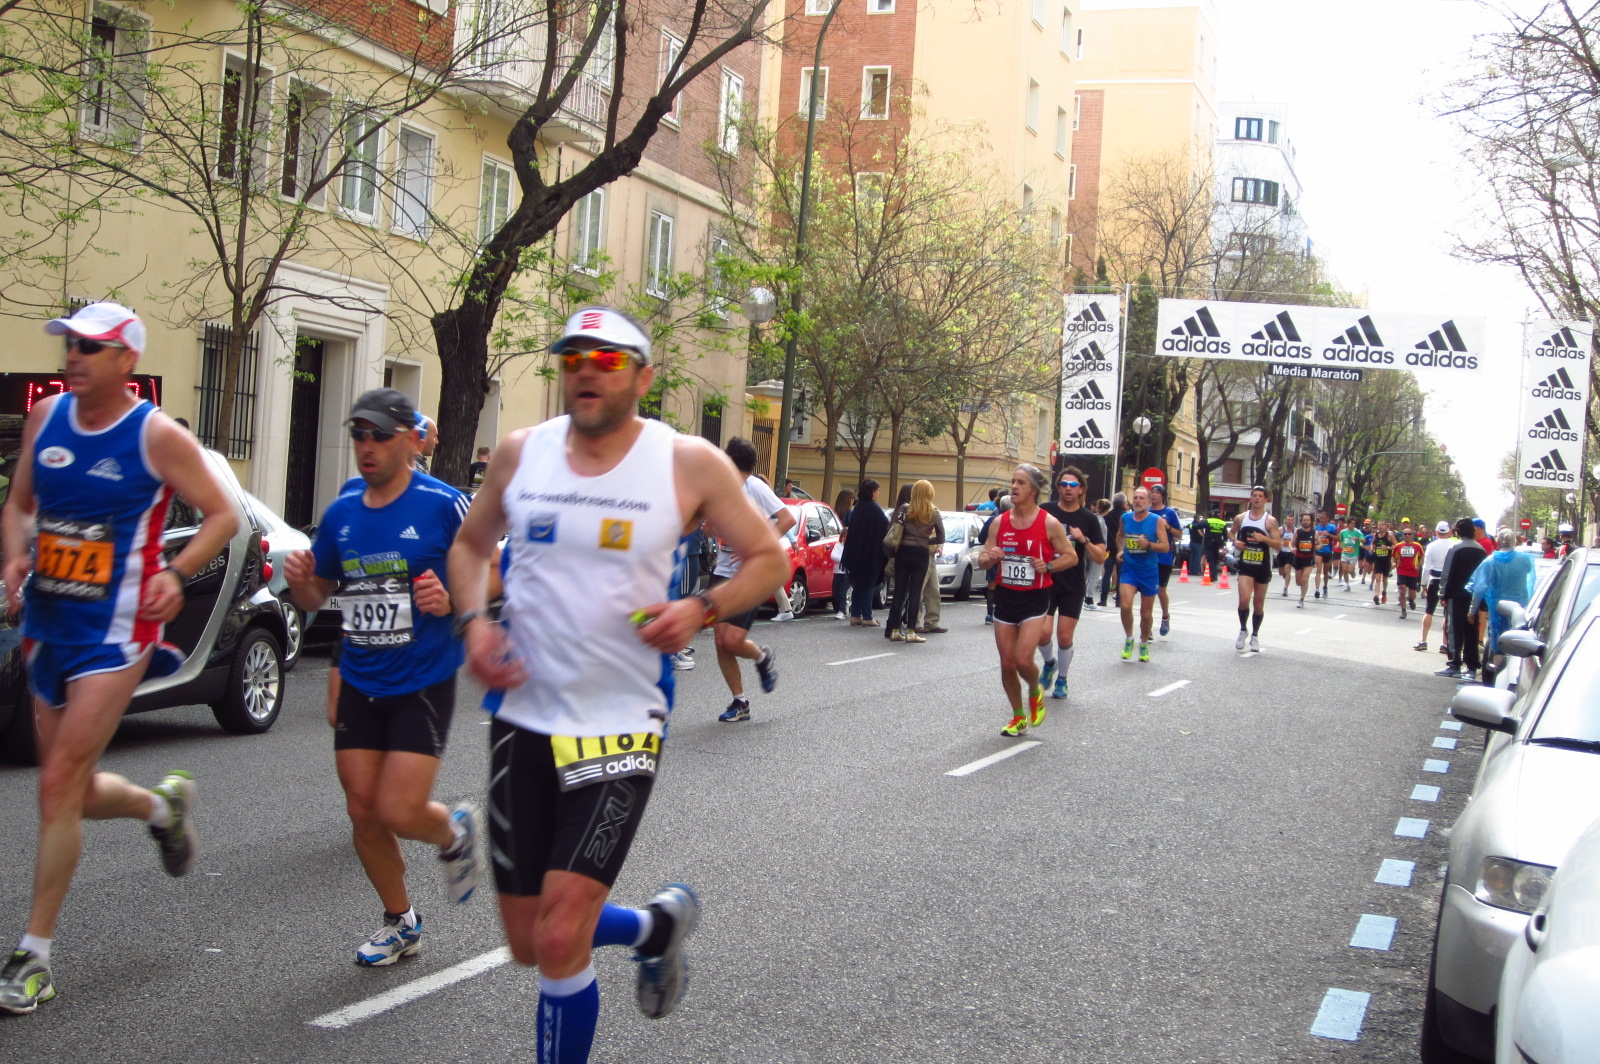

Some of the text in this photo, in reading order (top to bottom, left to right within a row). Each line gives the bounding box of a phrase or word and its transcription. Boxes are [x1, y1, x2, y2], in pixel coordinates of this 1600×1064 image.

[1067, 320, 1114, 333] adidas
[1162, 335, 1231, 354] adidas
[1241, 339, 1312, 359] adidas
[1322, 344, 1395, 364] adidas
[1405, 350, 1479, 370] adidas
[1535, 346, 1586, 360] adidas
[1065, 359, 1113, 372] adidas
[1272, 365, 1360, 381] Media Maratón
[1531, 386, 1582, 401] adidas
[1065, 399, 1112, 411] adidas
[1528, 427, 1579, 442] adidas
[1064, 437, 1111, 449] adidas
[1524, 468, 1575, 483] adidas
[1008, 565, 1026, 579] 108
[352, 603, 400, 630] 6997
[368, 632, 411, 645] adidas
[605, 754, 656, 774] adida
